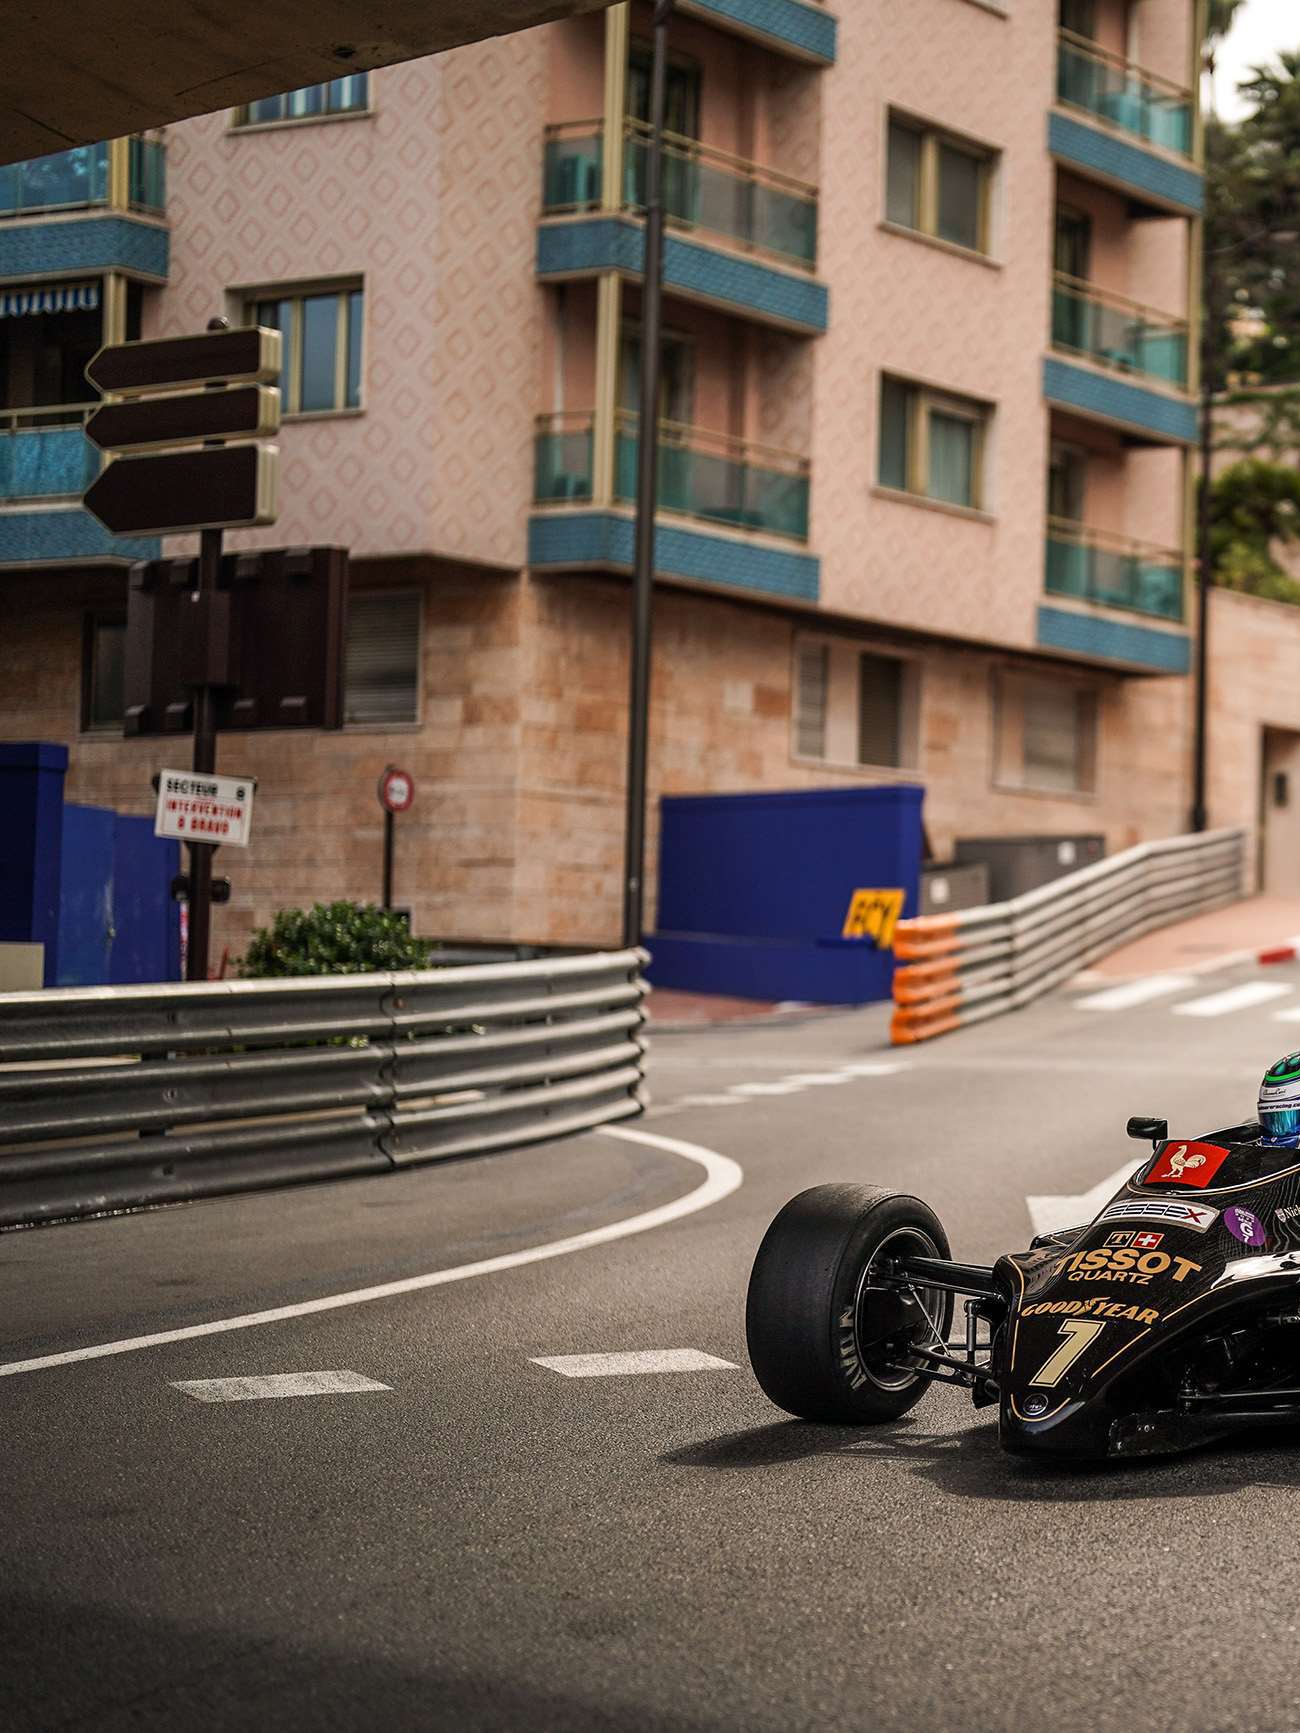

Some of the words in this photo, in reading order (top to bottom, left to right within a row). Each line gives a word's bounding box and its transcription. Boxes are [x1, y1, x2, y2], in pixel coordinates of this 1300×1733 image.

[1104, 1203, 1207, 1224] ESSEX
[1053, 1248, 1202, 1282] TISSOT
[1067, 1269, 1154, 1286] QUARTZ
[1020, 1296, 1161, 1325] GOODYEAR
[1028, 1319, 1106, 1388] 1
